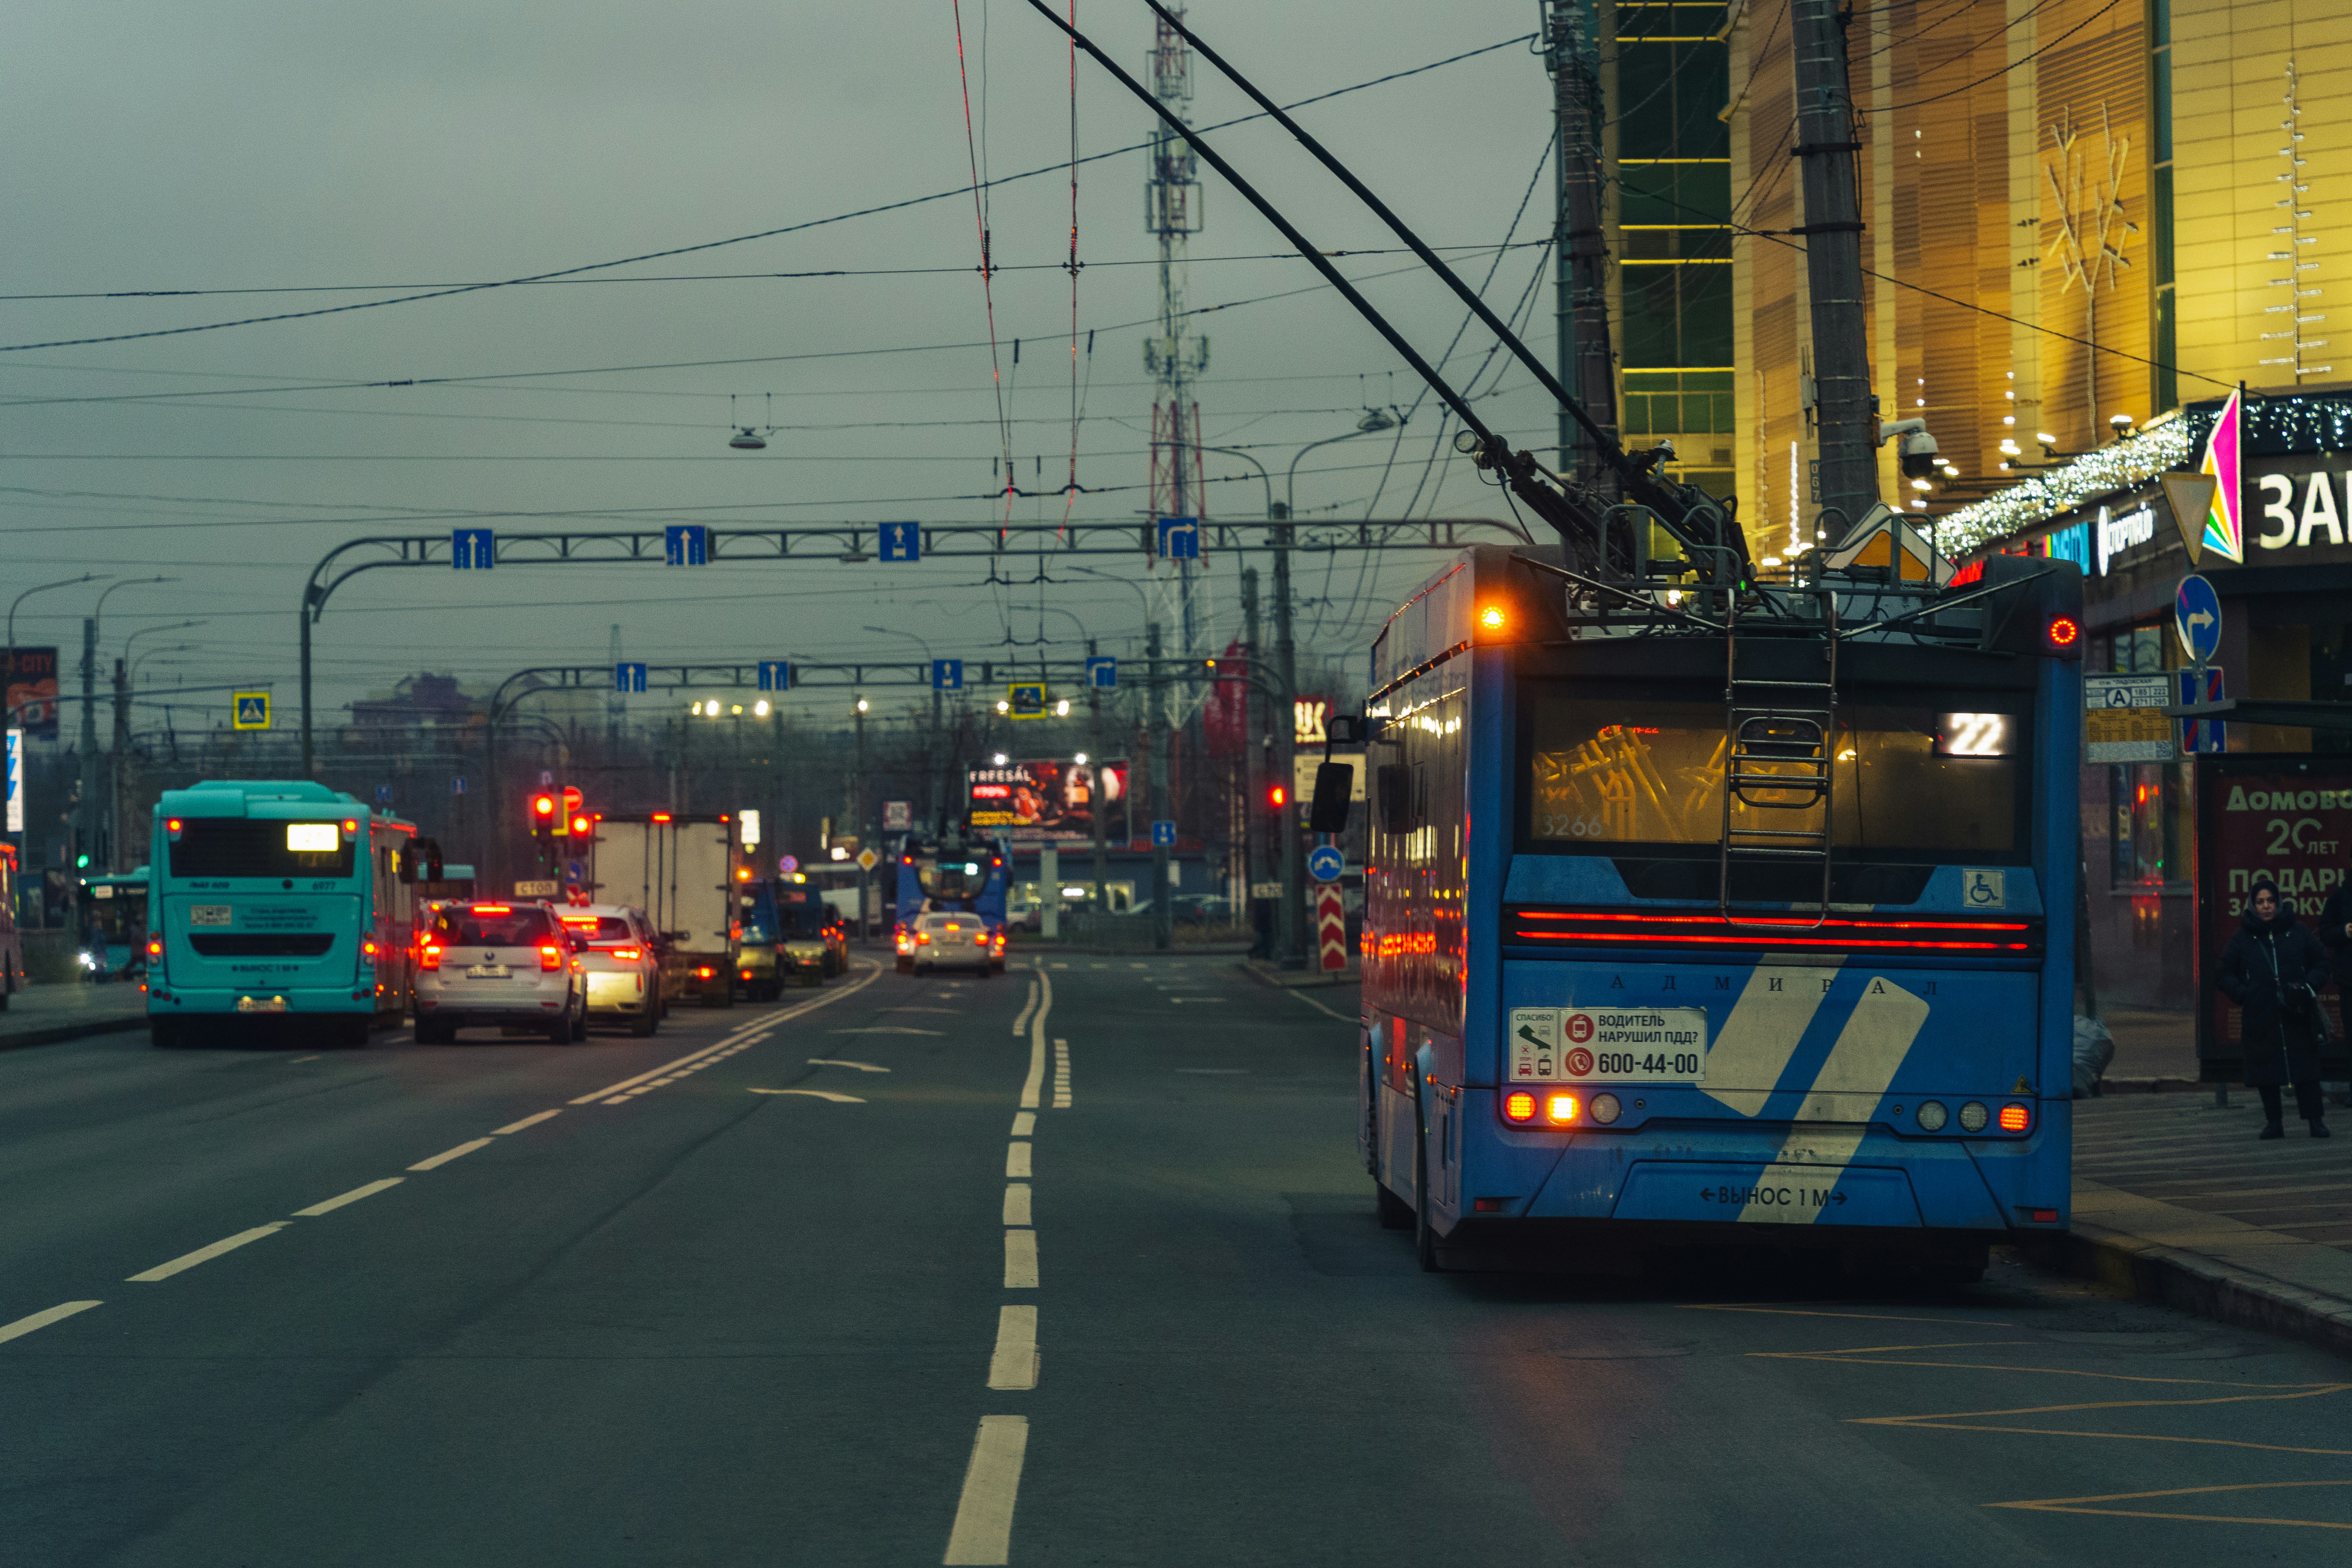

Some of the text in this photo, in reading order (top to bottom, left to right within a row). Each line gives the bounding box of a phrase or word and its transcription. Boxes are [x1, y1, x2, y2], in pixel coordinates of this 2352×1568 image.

[1811, 463, 1820, 501] 067
[2259, 470, 2352, 549] ЗА
[1950, 713, 2000, 756] 22
[1541, 813, 1602, 836] 3266
[2307, 840, 2339, 854] ЛЕТ
[1611, 976, 1937, 996] АДМИРАЛ
[1599, 1015, 1665, 1027] ВОДИТЕЛЬ
[1599, 1031, 1699, 1044] НАРУШИЛ ПДД?
[1599, 1053, 1699, 1073] 600-44-00
[1719, 1186, 1829, 1207] ВЫНОС 1 М
